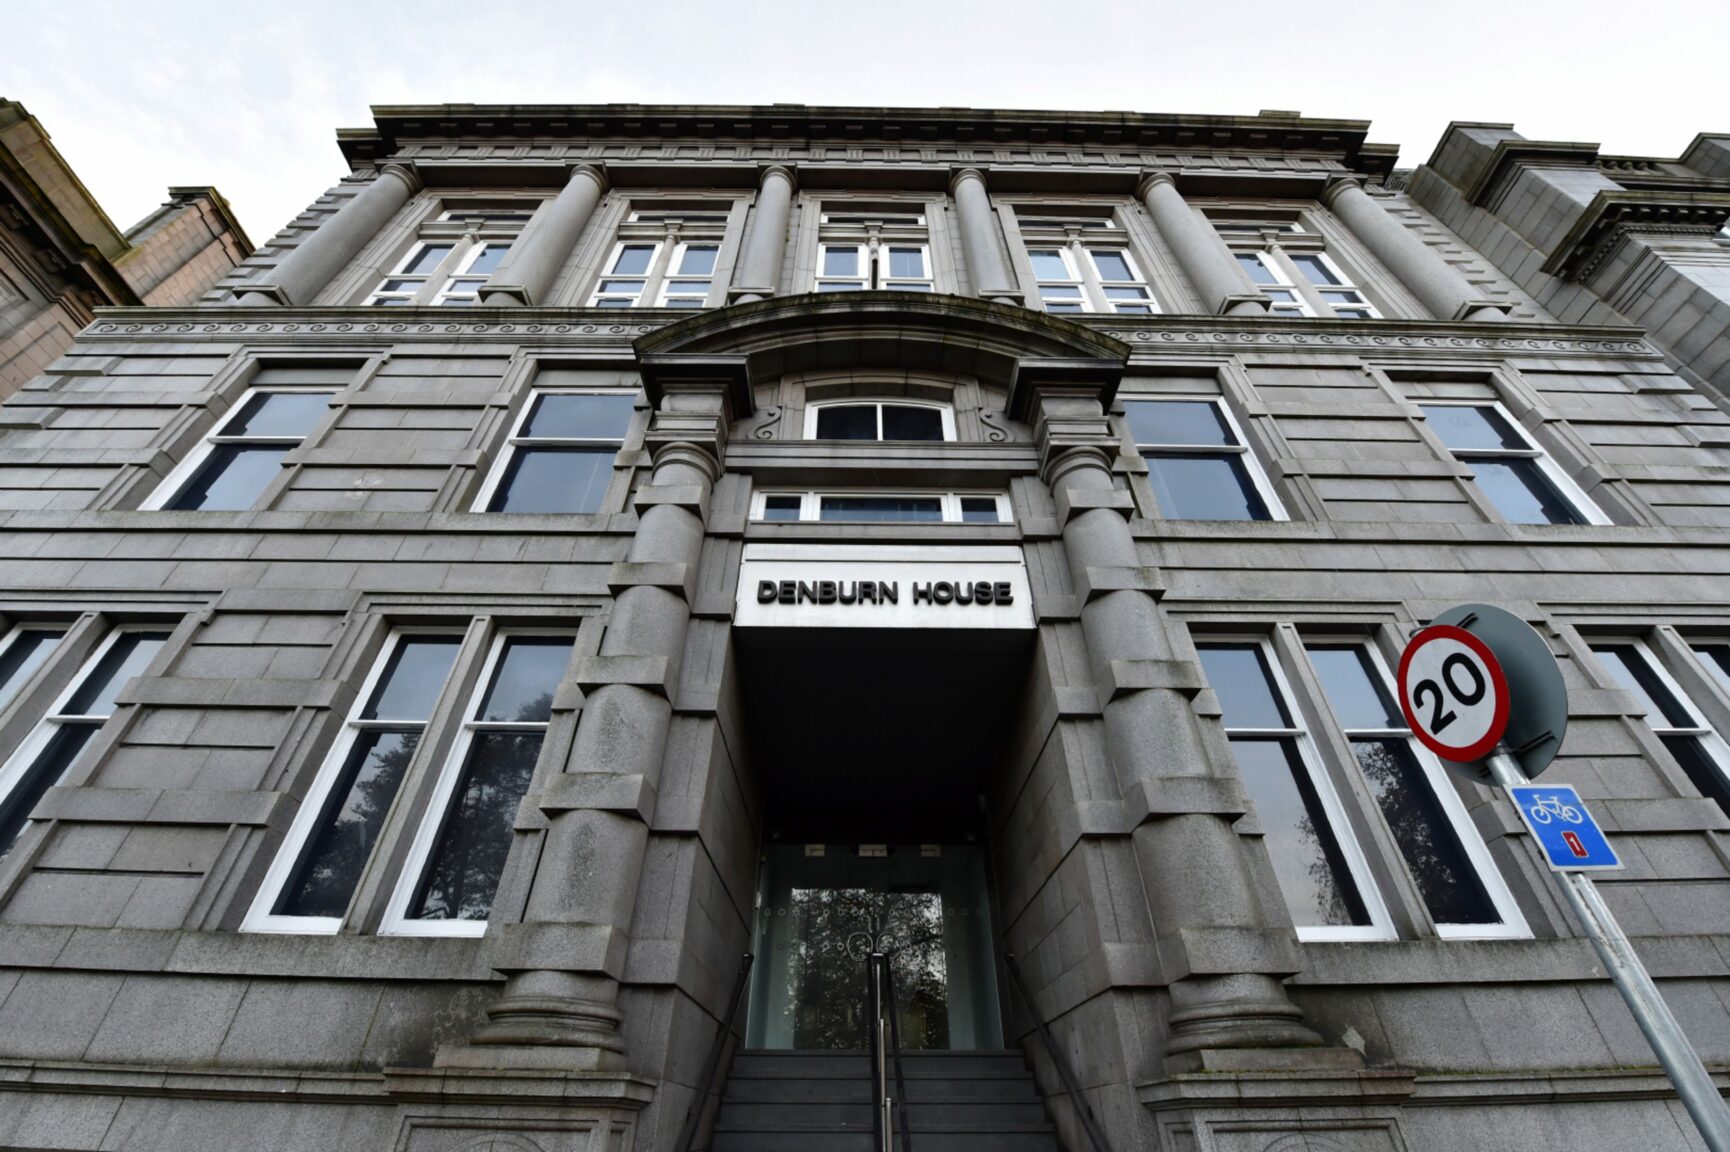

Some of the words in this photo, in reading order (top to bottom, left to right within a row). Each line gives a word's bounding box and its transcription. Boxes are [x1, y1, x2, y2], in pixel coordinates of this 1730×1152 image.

[757, 580, 899, 605] DENBURN
[912, 581, 1014, 606] HOUSE
[1413, 652, 1486, 735] 20
